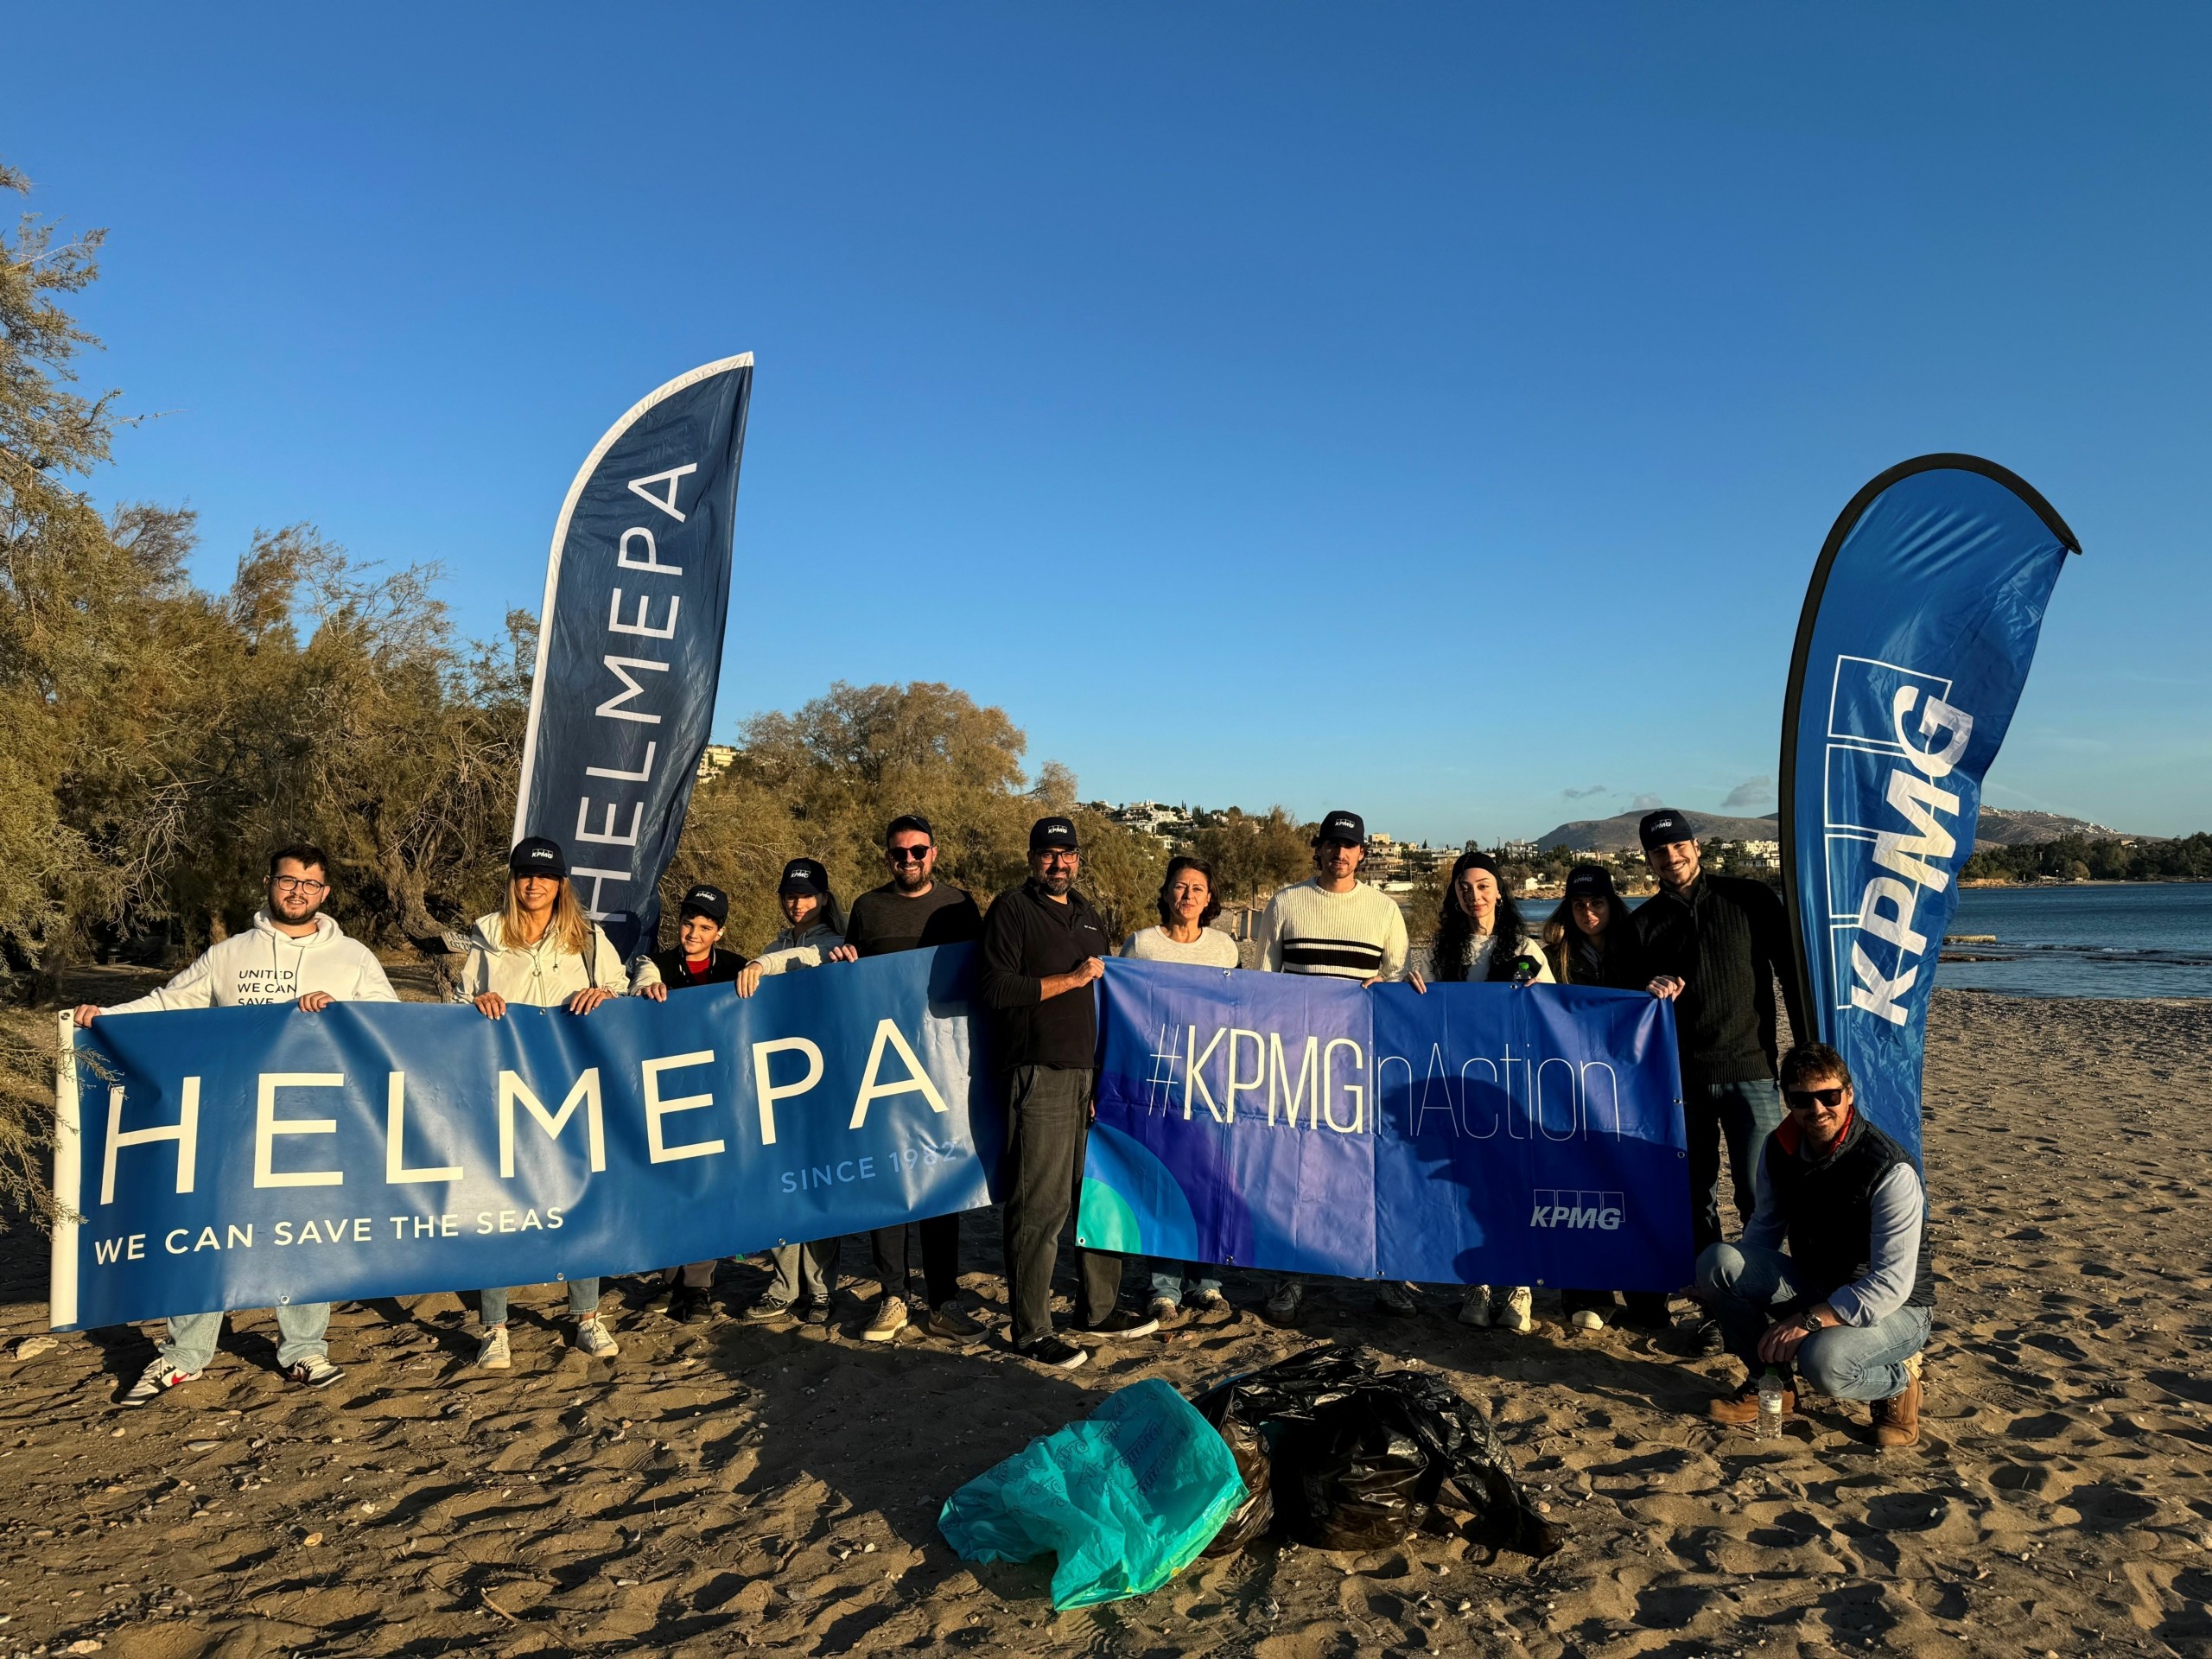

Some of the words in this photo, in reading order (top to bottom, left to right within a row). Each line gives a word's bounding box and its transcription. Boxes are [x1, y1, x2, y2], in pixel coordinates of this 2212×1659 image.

[570, 462, 697, 923] HELMEPA
[531, 850, 554, 860] KPMG
[1851, 684, 1974, 1027] KPMG
[238, 982, 261, 993] WE
[264, 983, 296, 993] CAN
[100, 1018, 949, 1205] HELMEPA
[781, 1156, 876, 1193] SINCE
[888, 1141, 957, 1173] 1982
[95, 1234, 146, 1265] WE
[165, 1224, 253, 1254] CAN
[273, 1217, 372, 1246] SAVE
[389, 1213, 459, 1240] THE
[476, 1206, 563, 1235] SEAS
[1529, 1205, 1623, 1230] KPMG
